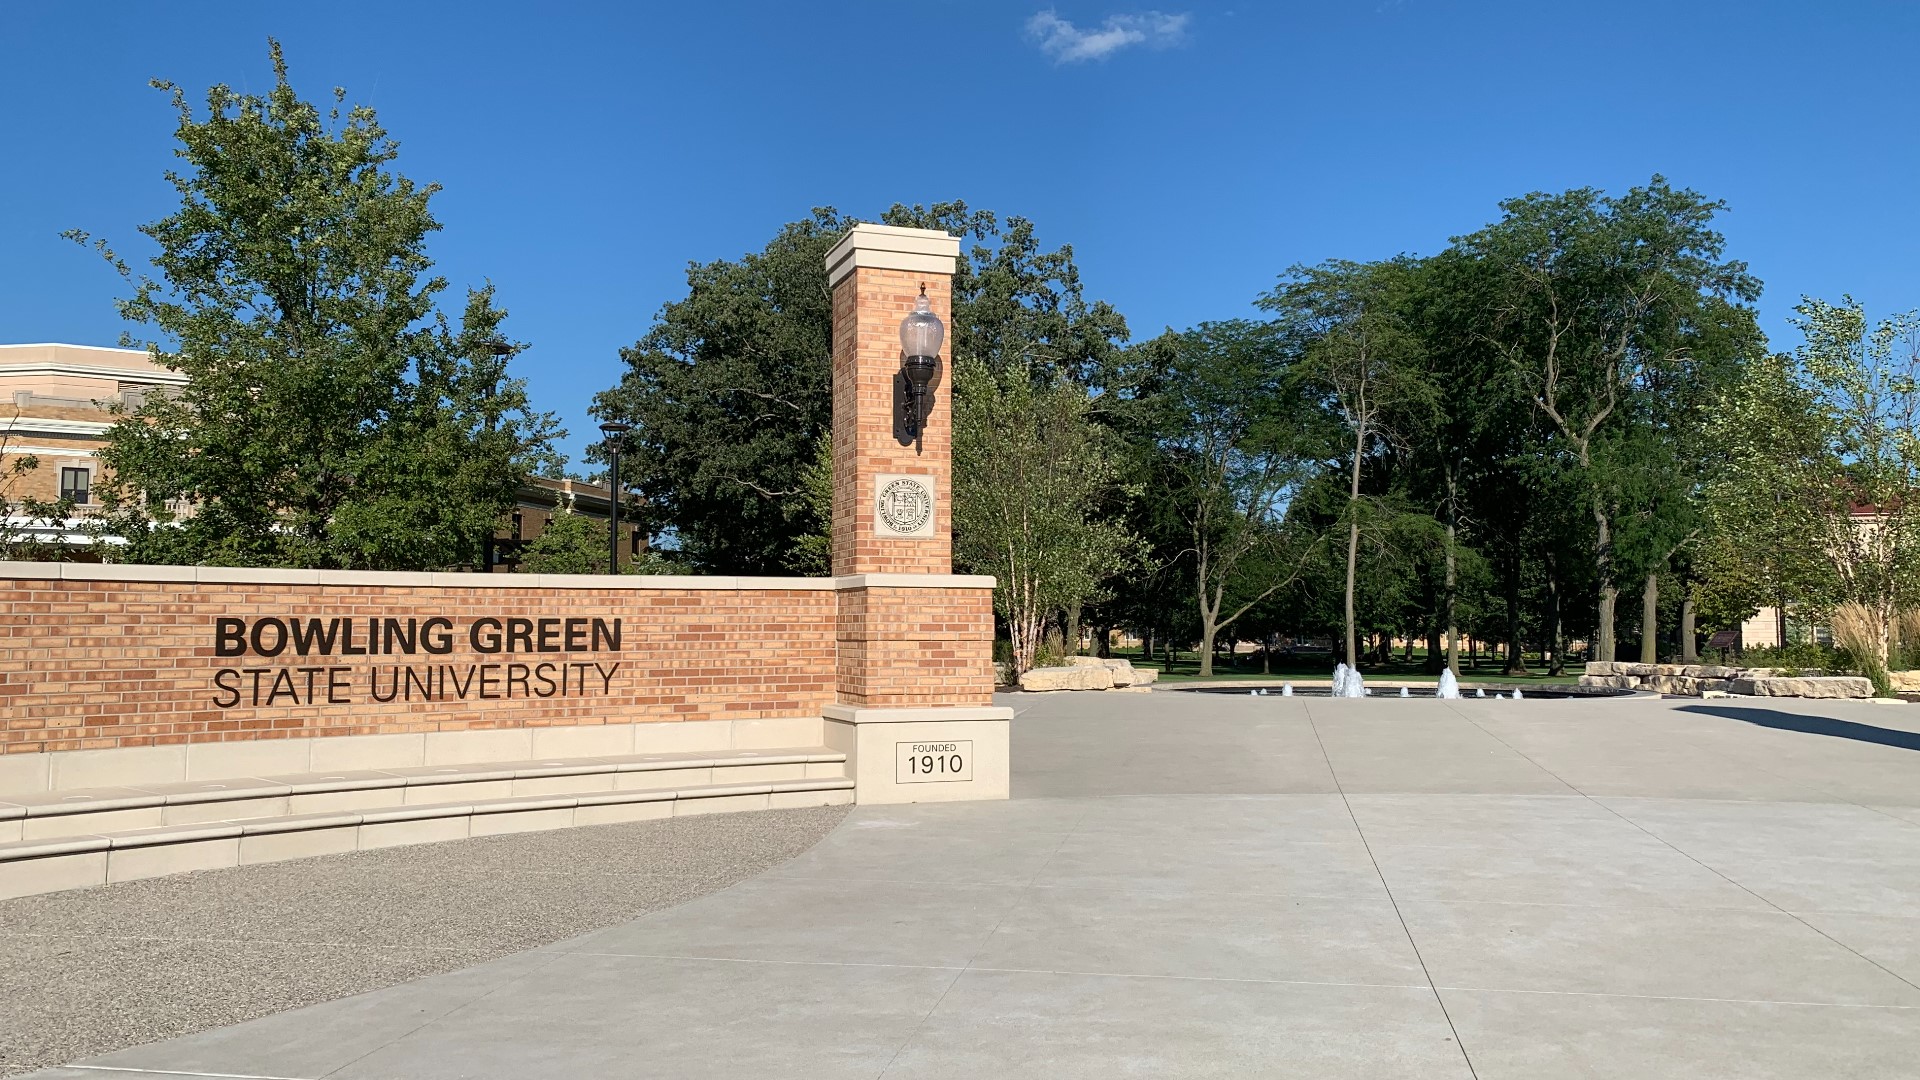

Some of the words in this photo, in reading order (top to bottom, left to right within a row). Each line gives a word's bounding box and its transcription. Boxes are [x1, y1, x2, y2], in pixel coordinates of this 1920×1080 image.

[882, 481, 900, 497] GREEN
[902, 480, 920, 488] STATE
[880, 500, 895, 526] BOWLING
[917, 490, 930, 526] UNIVERSITY
[215, 618, 453, 657] BOWLING
[469, 618, 621, 653] GREEN
[212, 667, 351, 708] STATE
[371, 662, 620, 702] UNIVERSITY
[912, 743, 957, 752] FOUNDED
[908, 754, 963, 774] 1910
